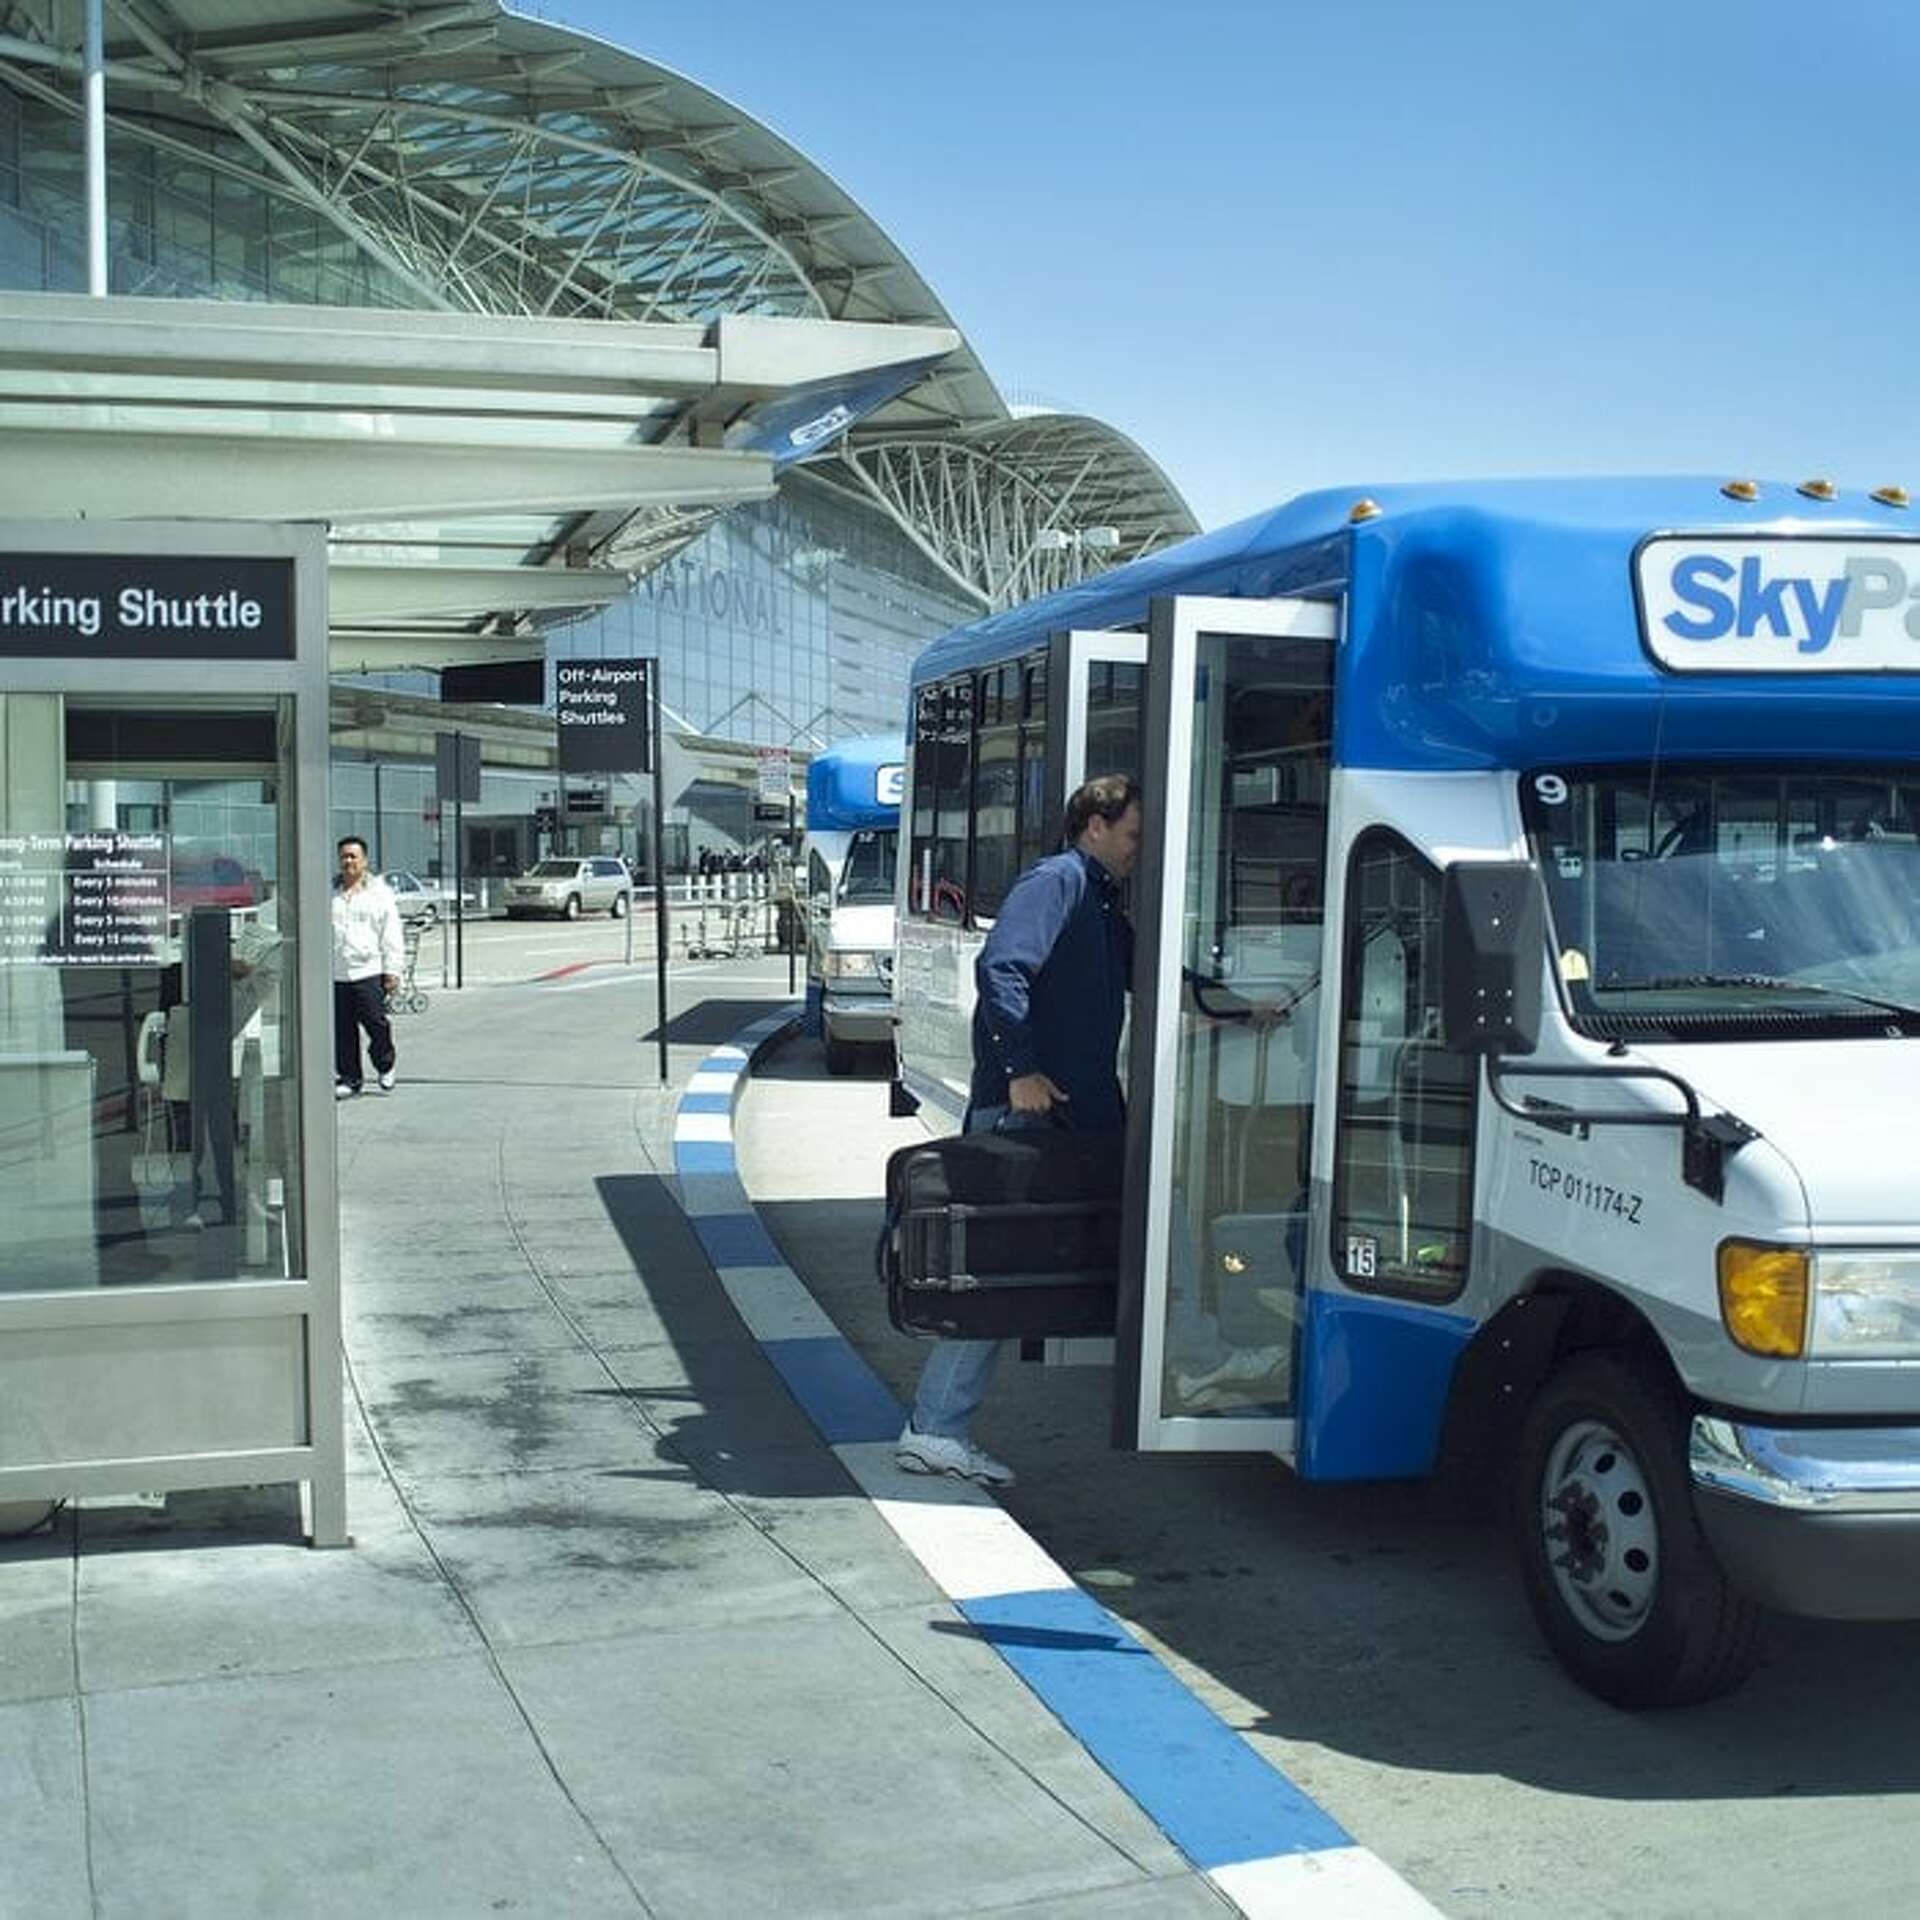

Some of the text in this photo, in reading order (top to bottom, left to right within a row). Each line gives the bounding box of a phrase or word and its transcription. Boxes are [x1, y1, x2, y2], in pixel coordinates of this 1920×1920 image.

[0, 586, 262, 635] rking Shuttle
[1664, 555, 1920, 653] SkyP
[559, 667, 645, 684] Off-Airport
[559, 688, 618, 706] Parking
[560, 709, 626, 725] Shuttles
[1535, 774, 1568, 805] 9
[65, 834, 113, 854] Parking
[115, 834, 162, 850] Shuttle
[73, 877, 103, 891] Every
[115, 877, 158, 888] minutes
[73, 896, 103, 909] Every
[73, 914, 104, 928] Every
[115, 915, 158, 926] minutes
[73, 934, 104, 946] Every
[1529, 1158, 1643, 1225] TCP 011174-Z
[1350, 1246, 1373, 1274] 15
